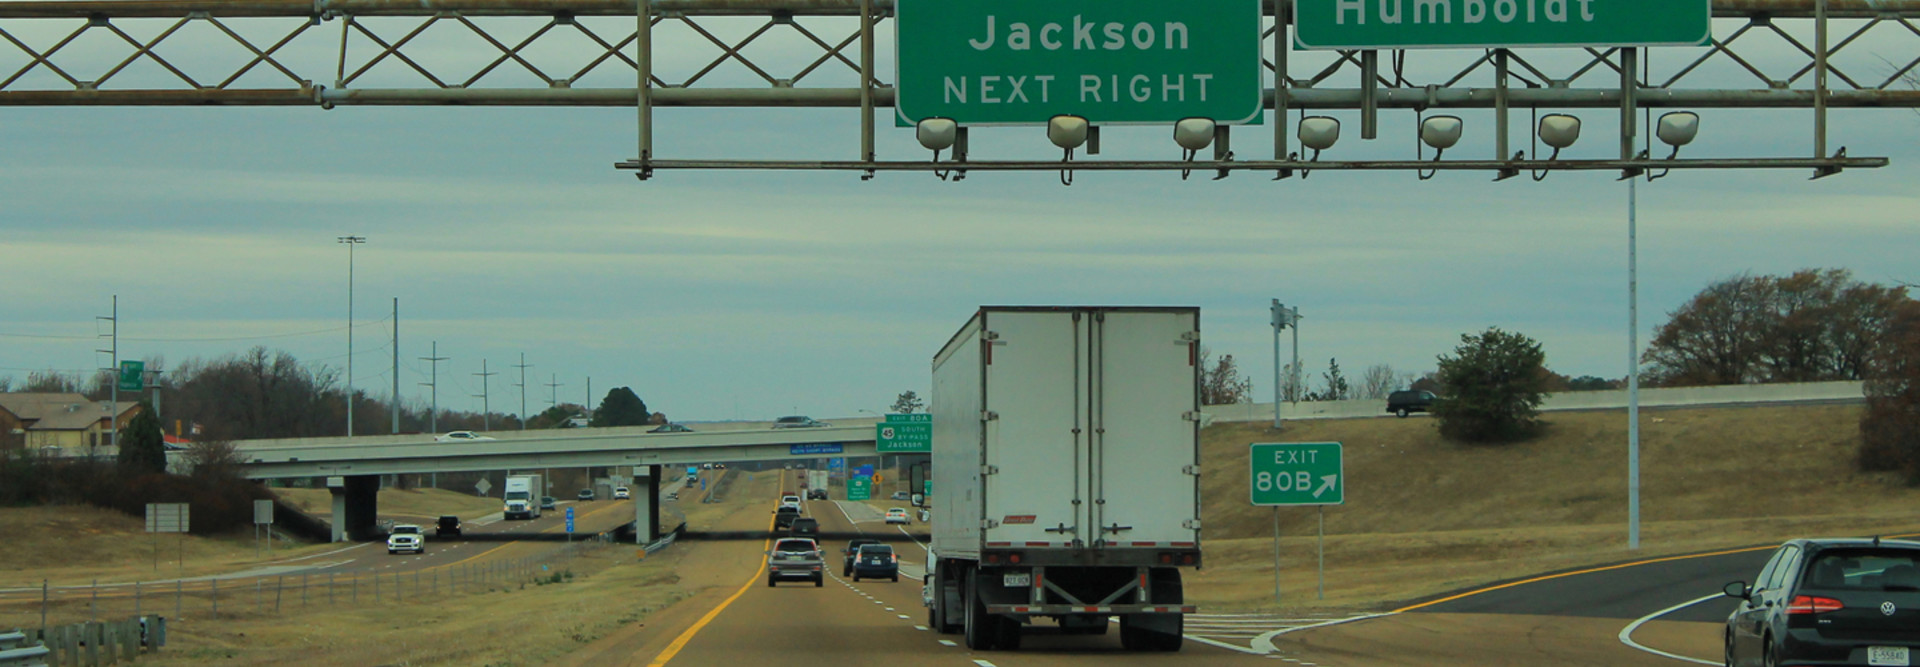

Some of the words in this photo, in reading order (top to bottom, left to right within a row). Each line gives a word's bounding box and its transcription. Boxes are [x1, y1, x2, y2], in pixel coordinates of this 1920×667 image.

[1336, 0, 1595, 25] Humboldt
[969, 14, 1189, 51] Jackson
[944, 75, 1055, 104] NEXT
[1080, 74, 1214, 103] RIGHT
[883, 429, 893, 438] 45
[887, 441, 923, 449] Jackson
[1275, 450, 1318, 464] EXIT
[1256, 471, 1312, 492] 80B
